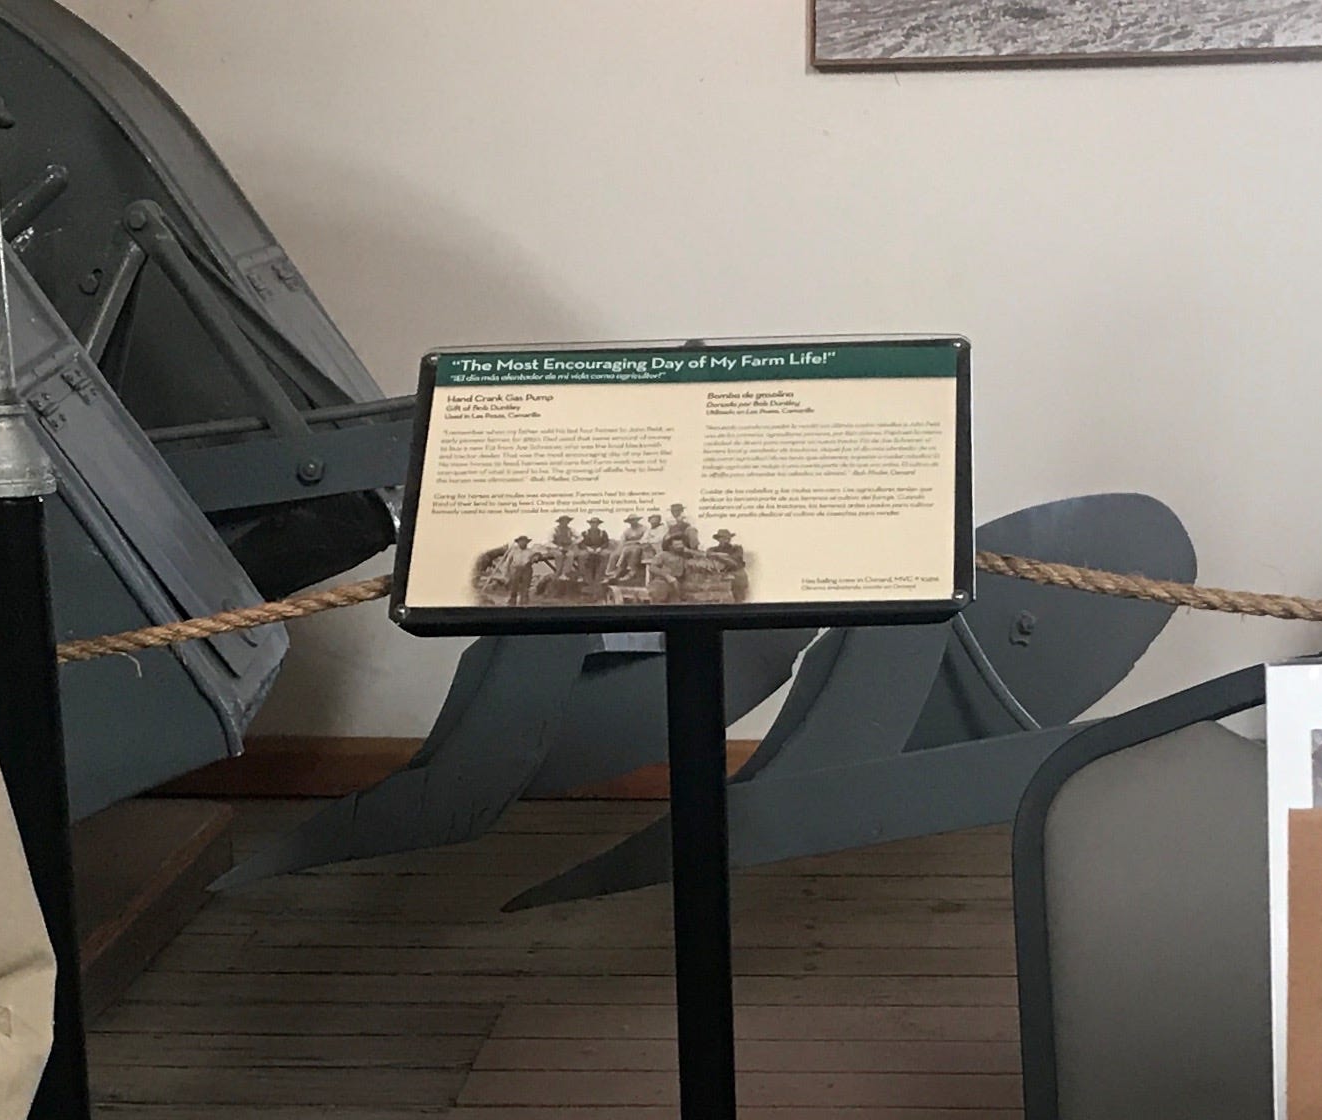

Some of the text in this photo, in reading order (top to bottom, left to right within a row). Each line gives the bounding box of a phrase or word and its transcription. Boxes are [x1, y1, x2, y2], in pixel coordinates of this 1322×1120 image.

[497, 359, 538, 371] Most
[544, 357, 647, 372] Encouraging
[652, 357, 683, 371] Day
[688, 356, 707, 368] of
[710, 356, 736, 370] My
[741, 355, 784, 367] Farm
[448, 394, 554, 404] Hand Crank Gas Pump
